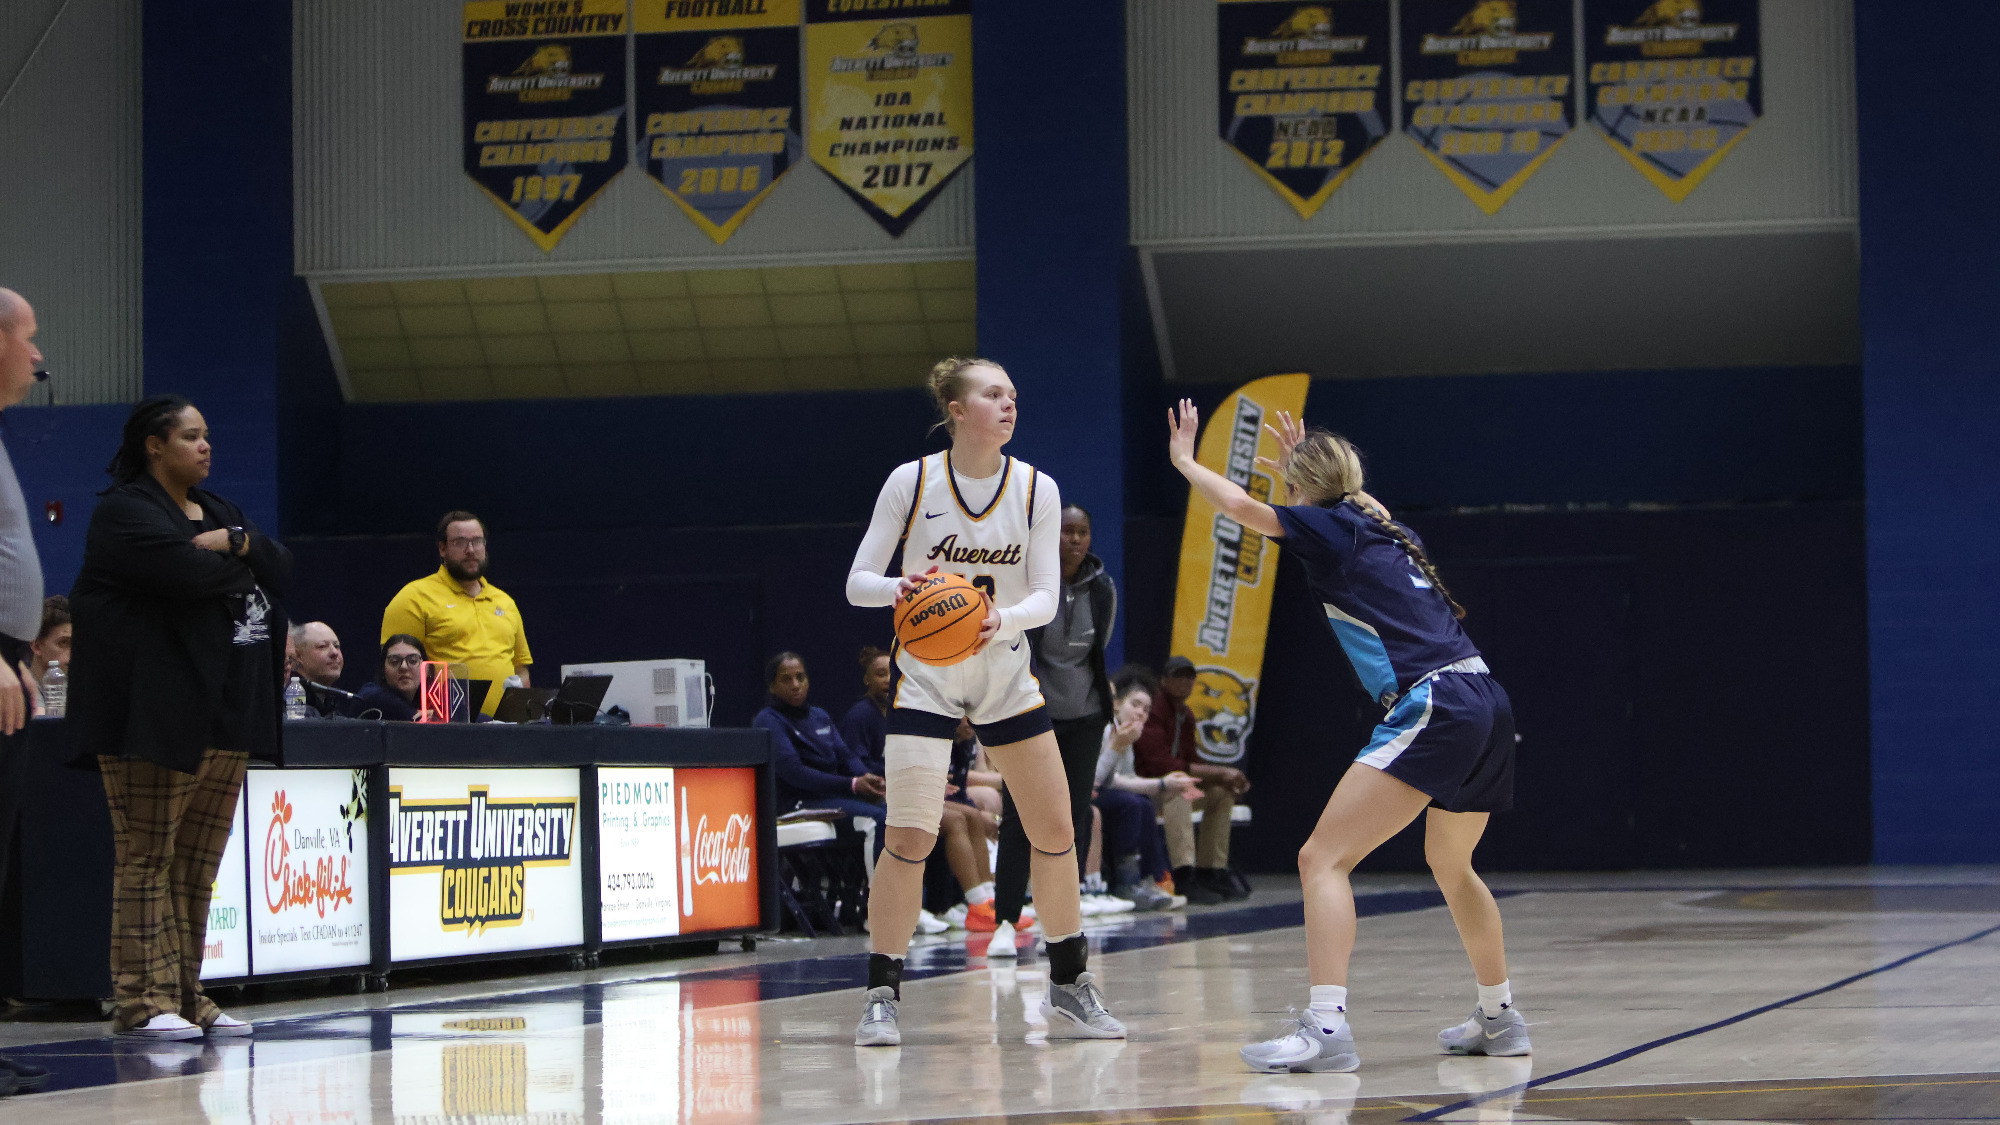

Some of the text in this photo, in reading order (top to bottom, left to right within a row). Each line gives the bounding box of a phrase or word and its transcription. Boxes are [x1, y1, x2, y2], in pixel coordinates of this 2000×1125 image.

[664, 0, 767, 19] FOOTBALL
[467, 14, 623, 38] CROSS COUNTRY
[1229, 64, 1381, 92] CONFERENCE
[1590, 56, 1755, 83] CONFERENCE
[1406, 75, 1569, 101] CONFERENCE
[1596, 80, 1749, 106] CHAMPIONS
[1234, 90, 1376, 117] CHAMPIONS
[1412, 101, 1563, 126] CHAMPIONS
[1644, 106, 1706, 123] NCAA
[475, 115, 617, 143] CONFERENCE
[646, 106, 792, 135] CONFERENCE
[839, 112, 946, 131] NATIONAL
[479, 140, 612, 167] CHAMPIONS
[650, 132, 786, 159] CHAMPIONS
[829, 135, 960, 158] CHAMPIONS
[1266, 138, 1345, 168] 2012
[510, 174, 582, 203] 1997
[862, 162, 934, 189] 2017
[1201, 399, 1260, 650] AVERETT UERSITY
[926, 534, 1021, 565] Averett
[910, 592, 968, 627] Wilson
[602, 782, 670, 805] PIEDMONT
[389, 796, 574, 863] AVERETT UNIVERSITY
[602, 810, 670, 832] Printing & Graphics
[295, 827, 340, 850] Danville, VA
[693, 813, 753, 886] Coca-Cola
[442, 865, 523, 919] COUGARS
[607, 872, 655, 891] 434.793.0026
[300, 926, 312, 941] Text
